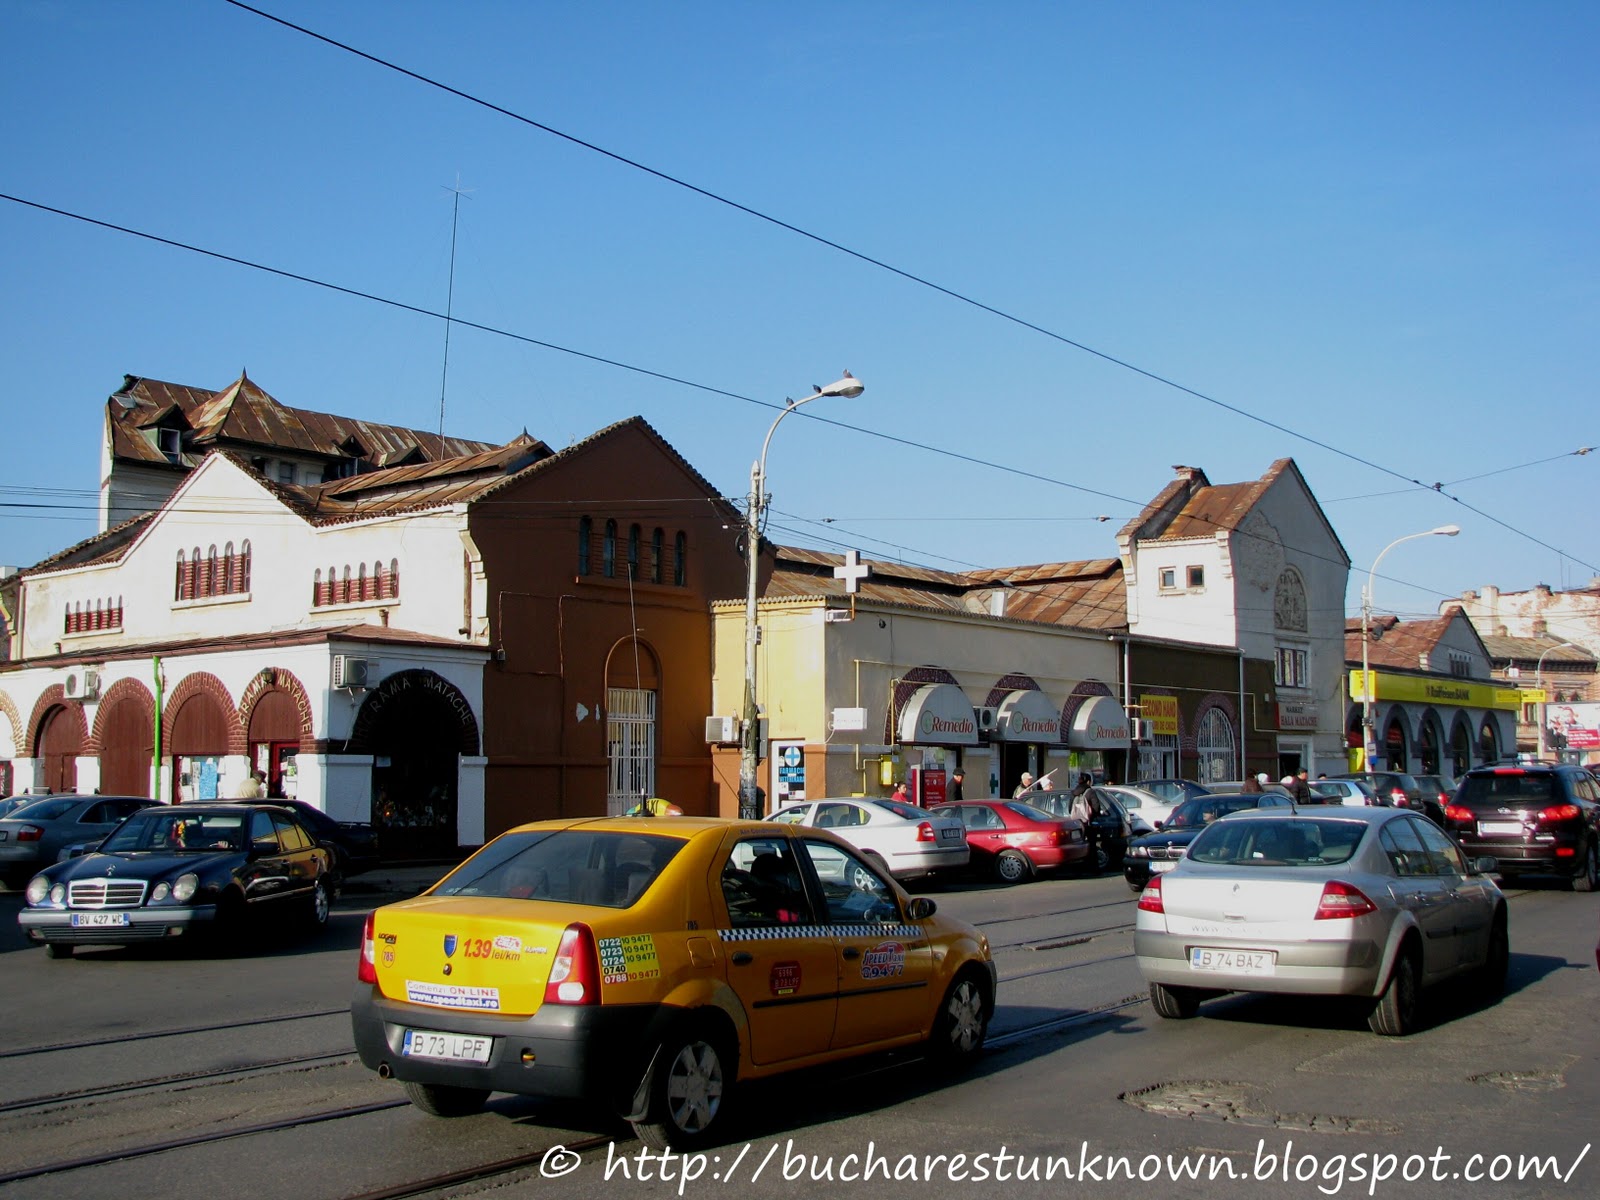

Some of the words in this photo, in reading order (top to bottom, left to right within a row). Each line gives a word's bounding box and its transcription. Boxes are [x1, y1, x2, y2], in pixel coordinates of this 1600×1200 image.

[239, 676, 268, 725] CRAMA
[278, 673, 311, 732] MATACHE
[424, 676, 474, 725] MATACHE
[932, 716, 974, 734] Remedio
[1021, 716, 1058, 733] Remedio
[1096, 726, 1128, 739] Remedio
[79, 915, 90, 925] BV
[93, 915, 109, 925] 427
[463, 938, 493, 959] 1.39
[598, 937, 621, 948] 0722
[621, 936, 630, 944] 10
[631, 934, 651, 943] 9477
[383, 951, 394, 962] 785
[491, 949, 521, 961] lei/km
[600, 947, 623, 957] 0723
[624, 945, 633, 953] 10
[633, 943, 653, 952] 9477
[602, 956, 625, 966] 0724
[636, 952, 656, 961] 9477
[1202, 952, 1212, 966] B
[1217, 952, 1232, 967] 74
[1236, 953, 1264, 969] BAZ
[603, 965, 626, 975] 0740
[604, 973, 627, 984] 0788
[638, 969, 659, 979] 9477
[871, 964, 904, 978] 9477
[407, 981, 446, 994] Comenzi
[449, 986, 497, 997] ON-LINE
[409, 991, 498, 1009] www.speedtaxi.ro
[413, 1035, 424, 1054] B
[428, 1036, 446, 1056] 73
[452, 1038, 485, 1059] LPF
